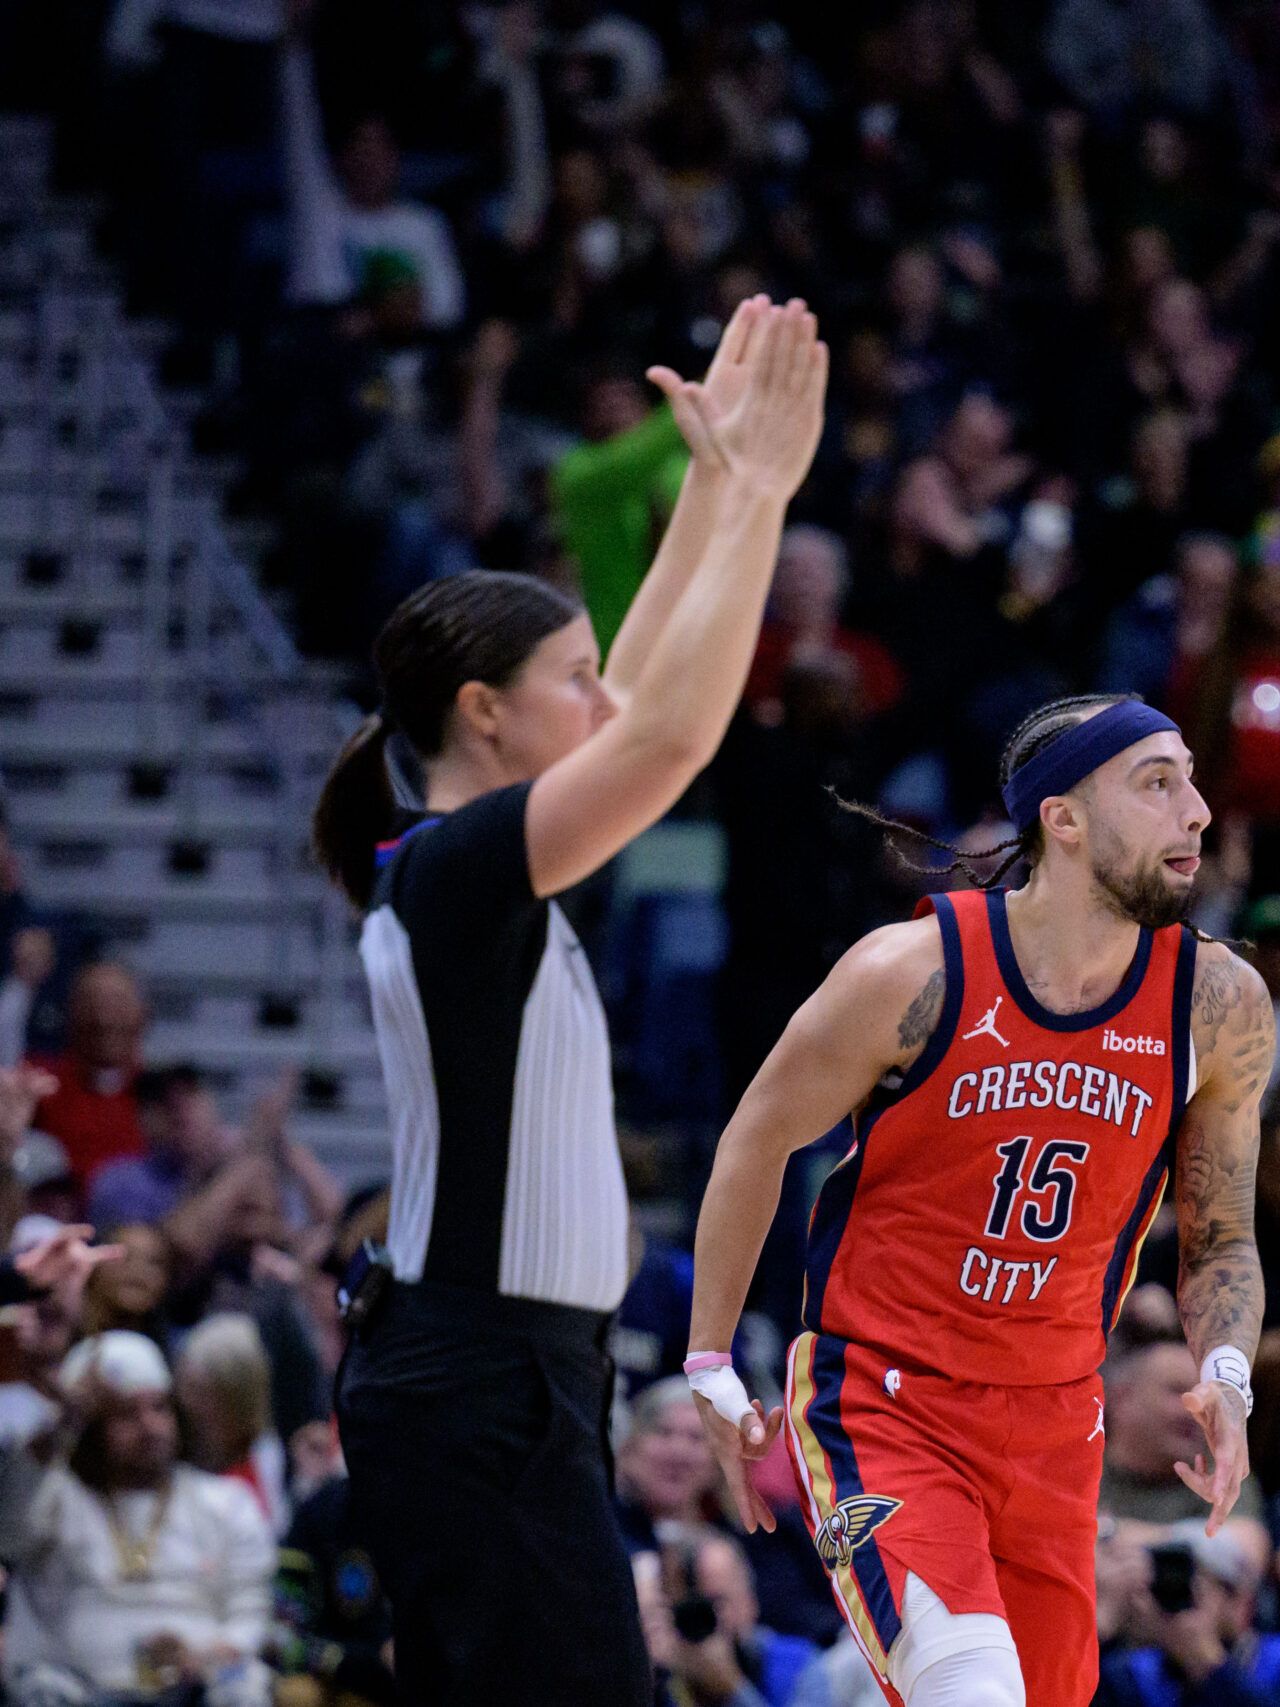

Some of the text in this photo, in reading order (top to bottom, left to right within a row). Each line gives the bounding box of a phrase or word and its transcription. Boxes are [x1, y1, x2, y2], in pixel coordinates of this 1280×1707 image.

[1102, 1029, 1166, 1056] ibotta
[947, 1060, 1153, 1138] CRESCENT
[983, 1135, 1090, 1243] 15
[958, 1246, 1059, 1304] CITY
